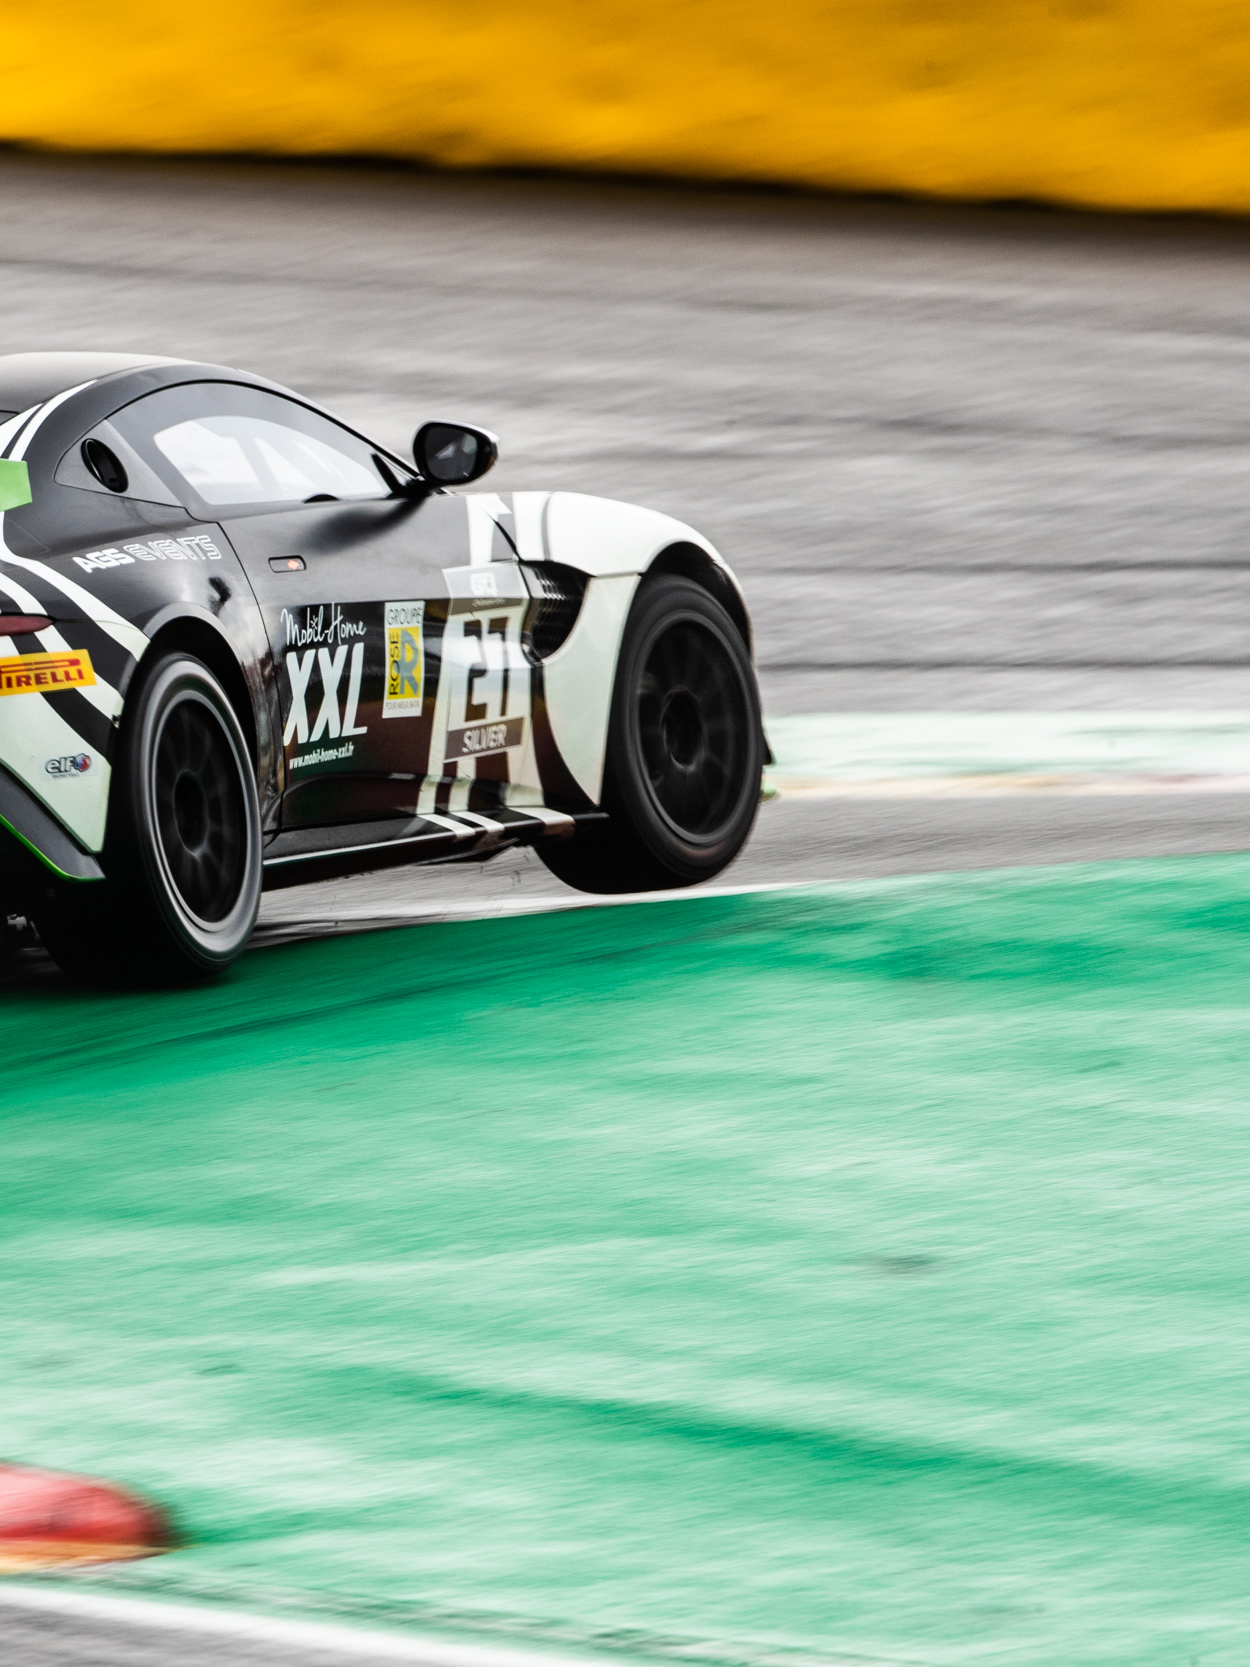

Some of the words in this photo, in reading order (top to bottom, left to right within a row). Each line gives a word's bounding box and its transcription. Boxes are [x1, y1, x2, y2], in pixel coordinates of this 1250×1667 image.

[73, 548, 135, 573] AGS
[123, 535, 221, 561] EVENTS
[280, 602, 367, 646] Mobil-Home
[387, 607, 422, 625] GROUPE
[388, 632, 401, 695] ROSE
[282, 642, 368, 747] XXL
[462, 723, 507, 753] SILVER
[45, 755, 76, 774] elf
